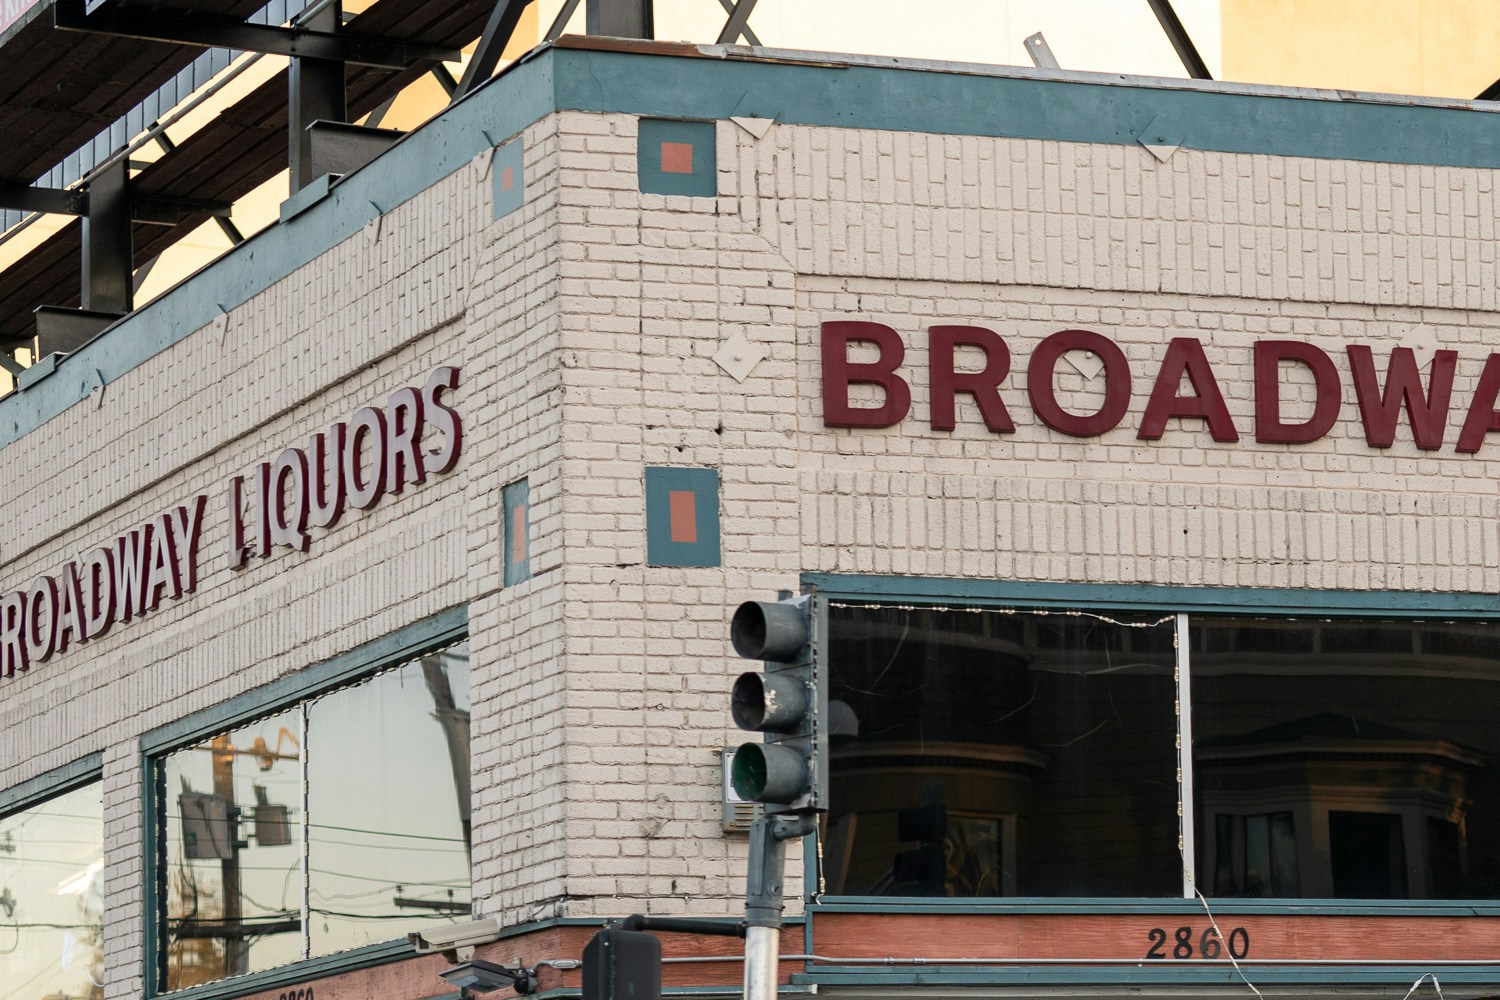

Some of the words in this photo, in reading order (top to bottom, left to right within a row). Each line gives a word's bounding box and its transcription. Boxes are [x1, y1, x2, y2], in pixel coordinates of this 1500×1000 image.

[0, 494, 207, 680] ROADWAY
[228, 366, 463, 571] LIQUORS
[1146, 926, 1249, 960] 2860
